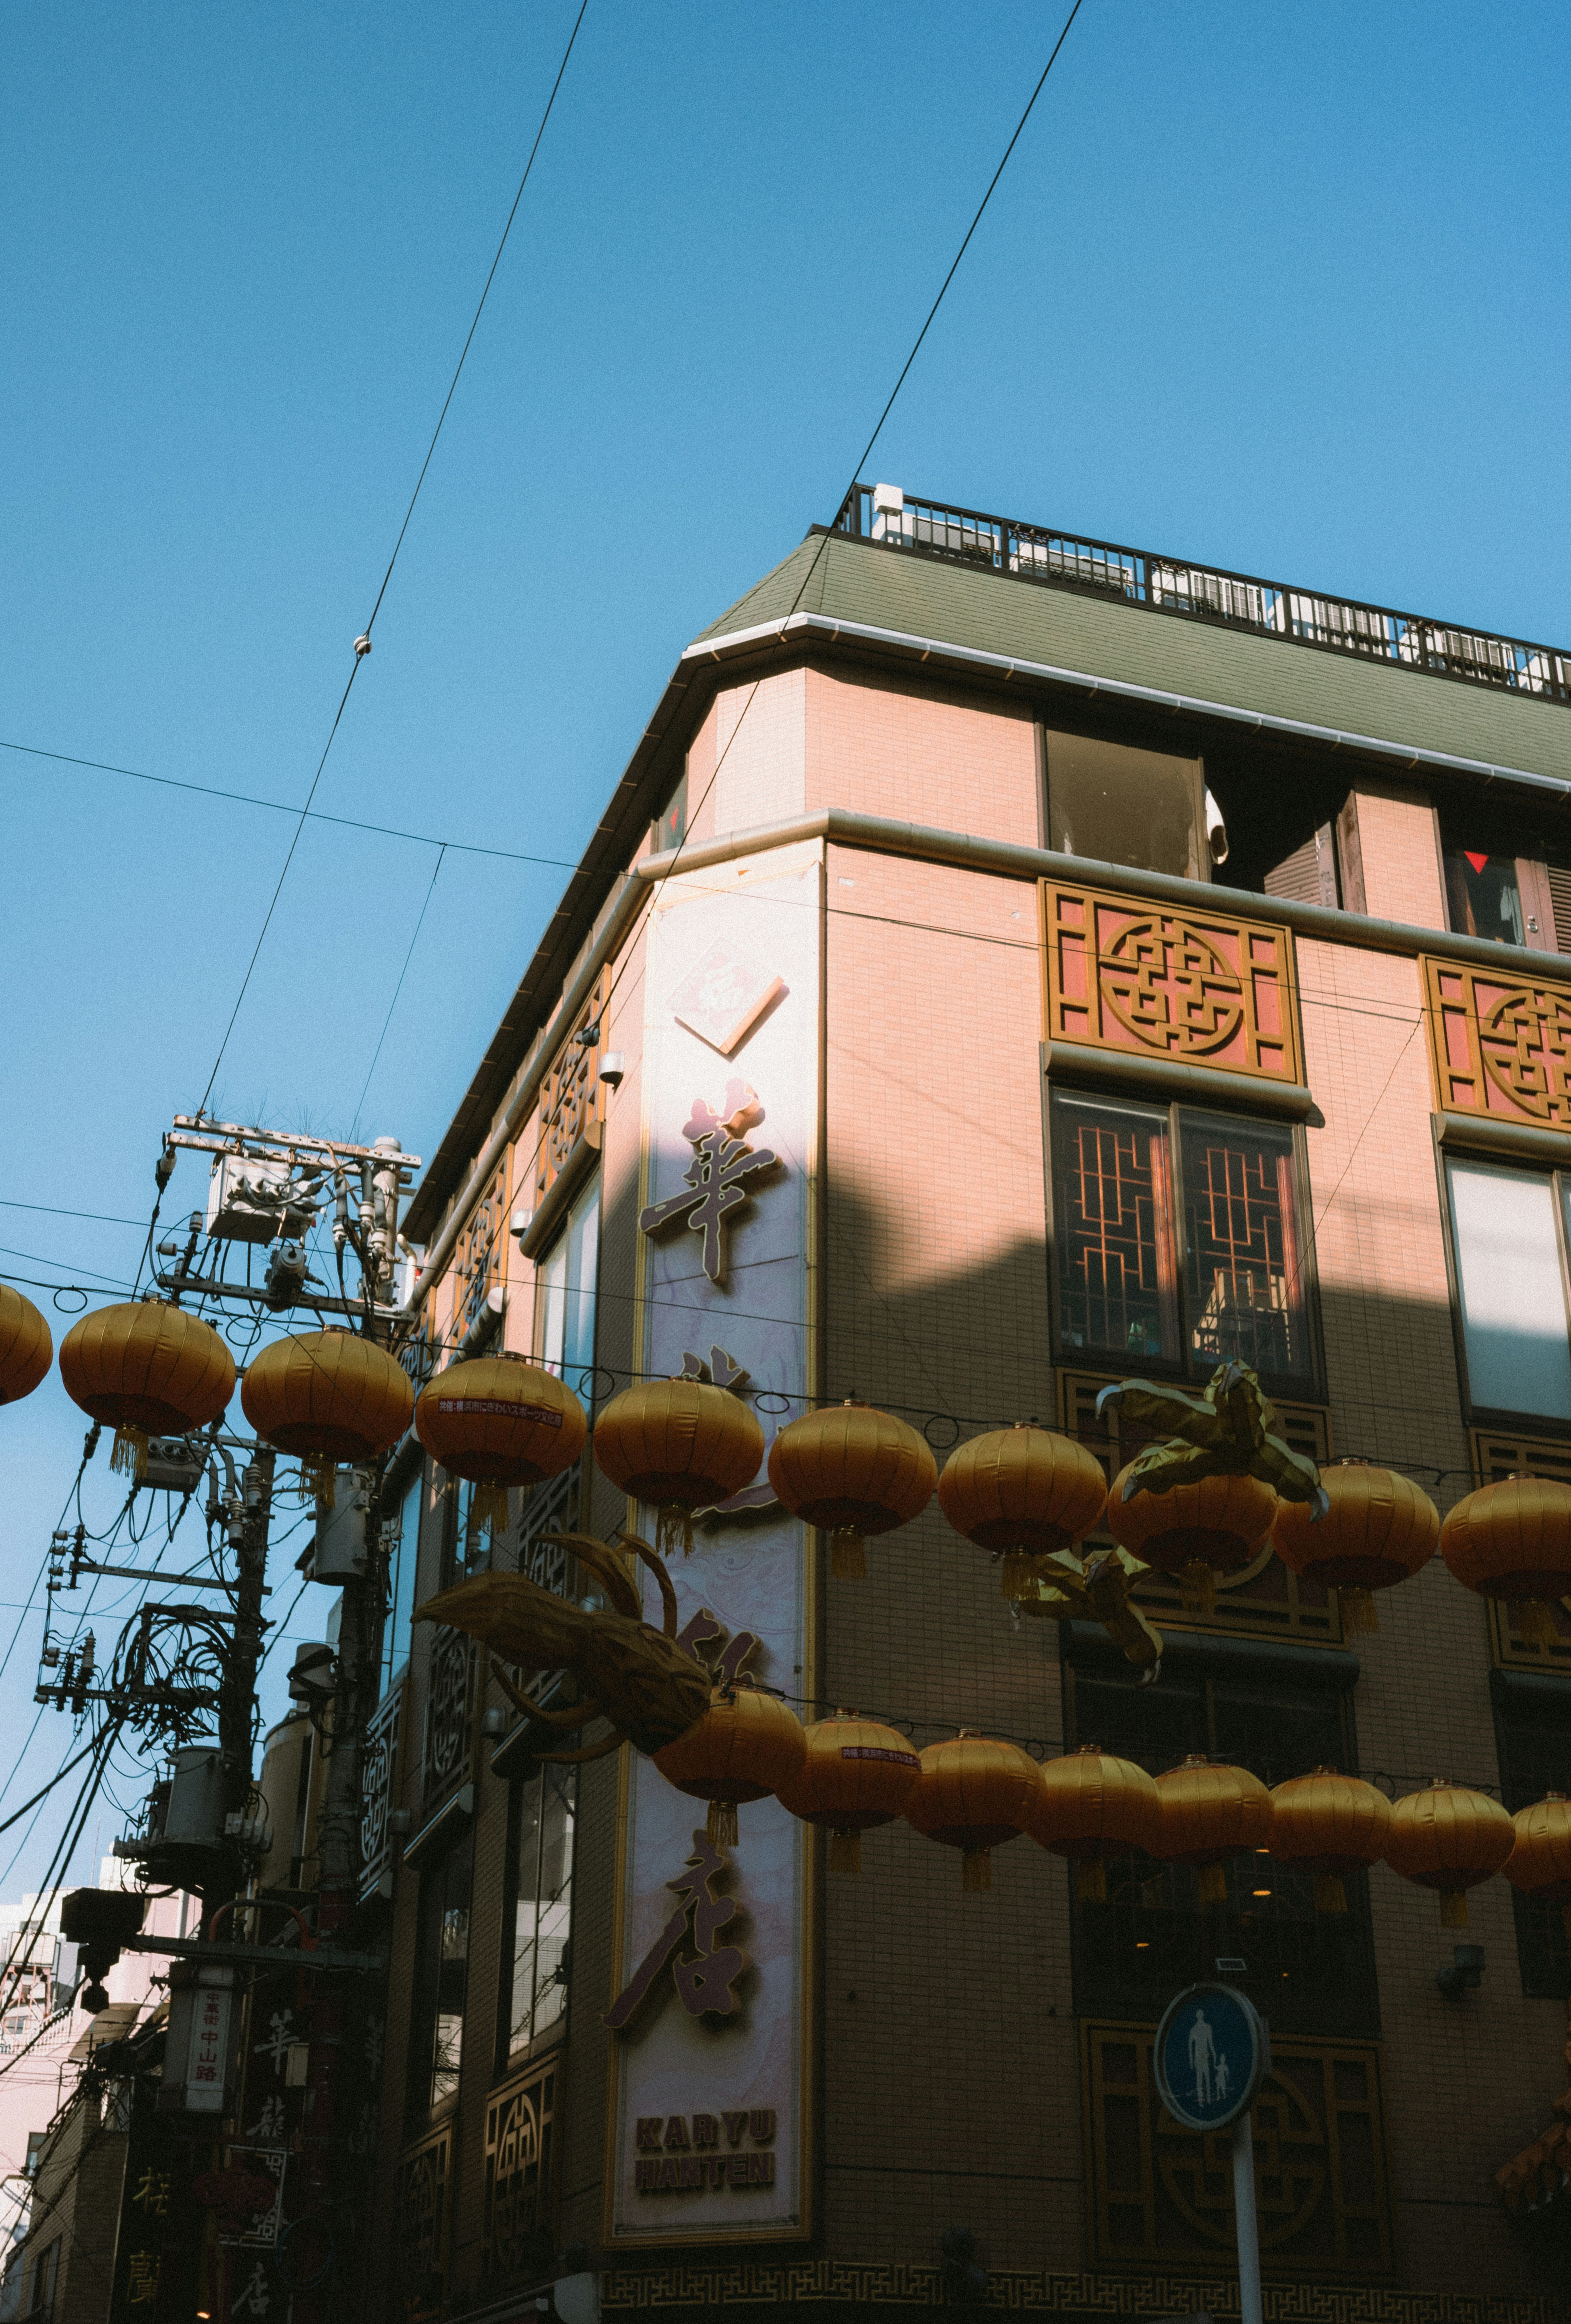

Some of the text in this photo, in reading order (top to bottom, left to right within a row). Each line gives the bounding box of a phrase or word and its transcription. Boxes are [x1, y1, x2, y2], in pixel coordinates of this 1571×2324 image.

[196, 1992, 220, 2081] 中華街 中山路
[636, 2110, 776, 2150] KARYU
[635, 2152, 775, 2190] HANTEN
